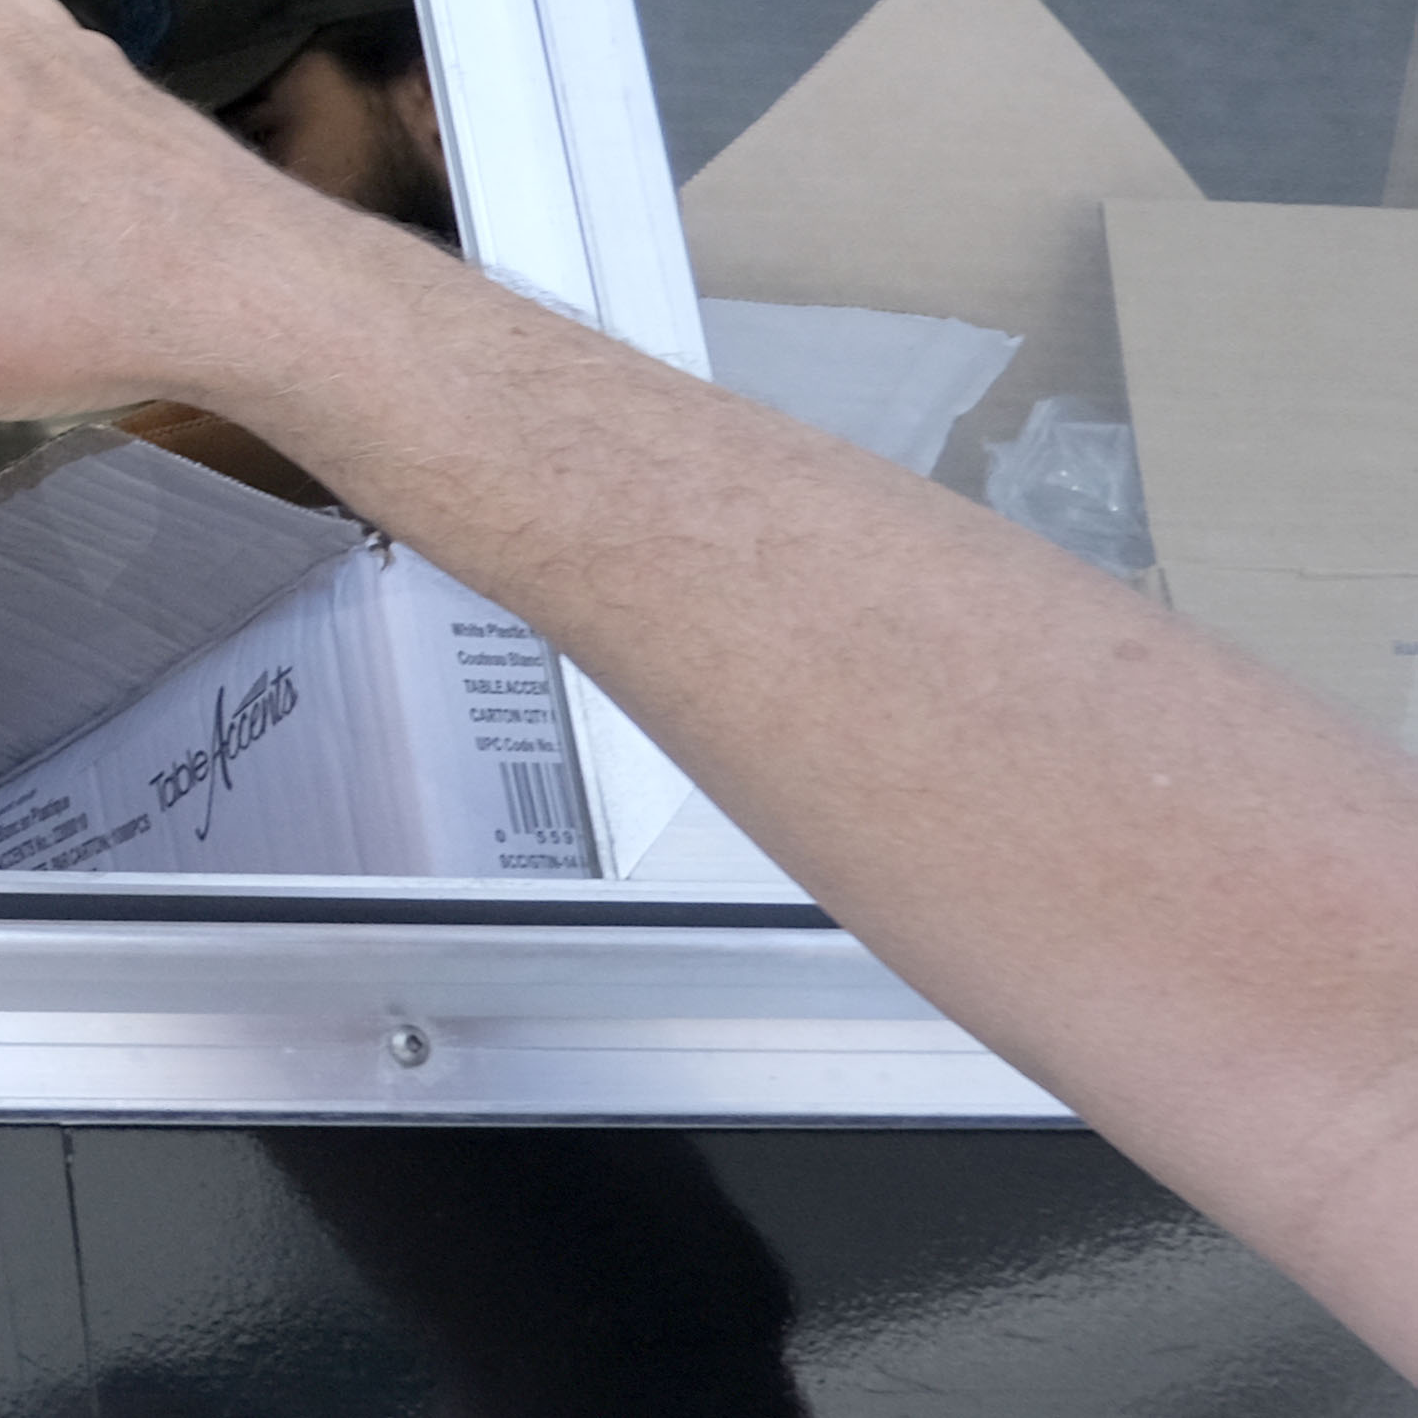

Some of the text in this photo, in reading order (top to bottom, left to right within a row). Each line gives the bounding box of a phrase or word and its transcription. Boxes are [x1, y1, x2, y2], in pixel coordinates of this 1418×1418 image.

[463, 678, 550, 695] TABLE ACCEN
[468, 708, 522, 723] CARTON
[475, 736, 502, 751] UPC
[504, 737, 535, 751] Code
[148, 665, 299, 842] Table Accents
